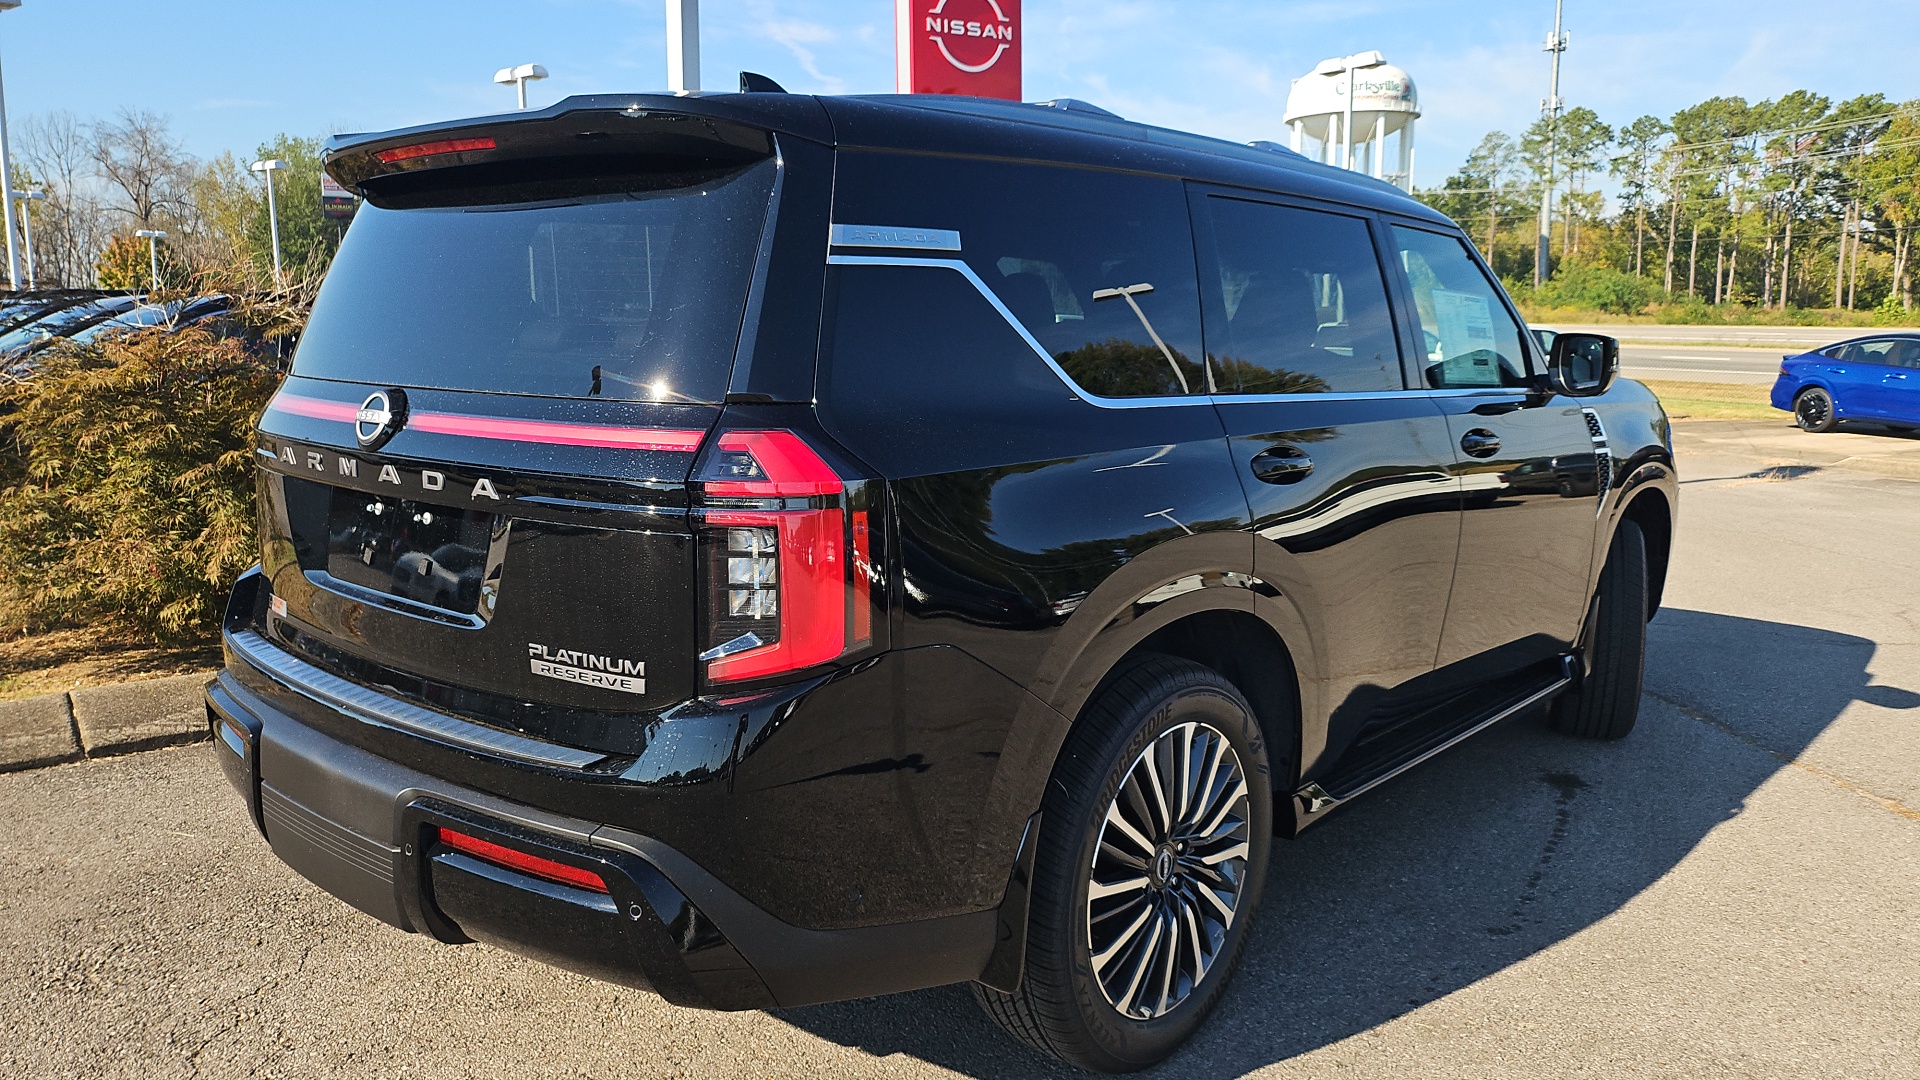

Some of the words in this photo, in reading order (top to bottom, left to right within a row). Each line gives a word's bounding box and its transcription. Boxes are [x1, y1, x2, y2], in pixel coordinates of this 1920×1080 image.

[925, 16, 1013, 41] NISSAN
[1336, 80, 1400, 95] Carksville
[851, 230, 941, 243] ARMADA
[279, 446, 501, 501] ARMADA
[528, 642, 646, 677] PLATINUM
[540, 664, 632, 690] RESERVE
[1092, 702, 1173, 828] BRIDGESTONE
